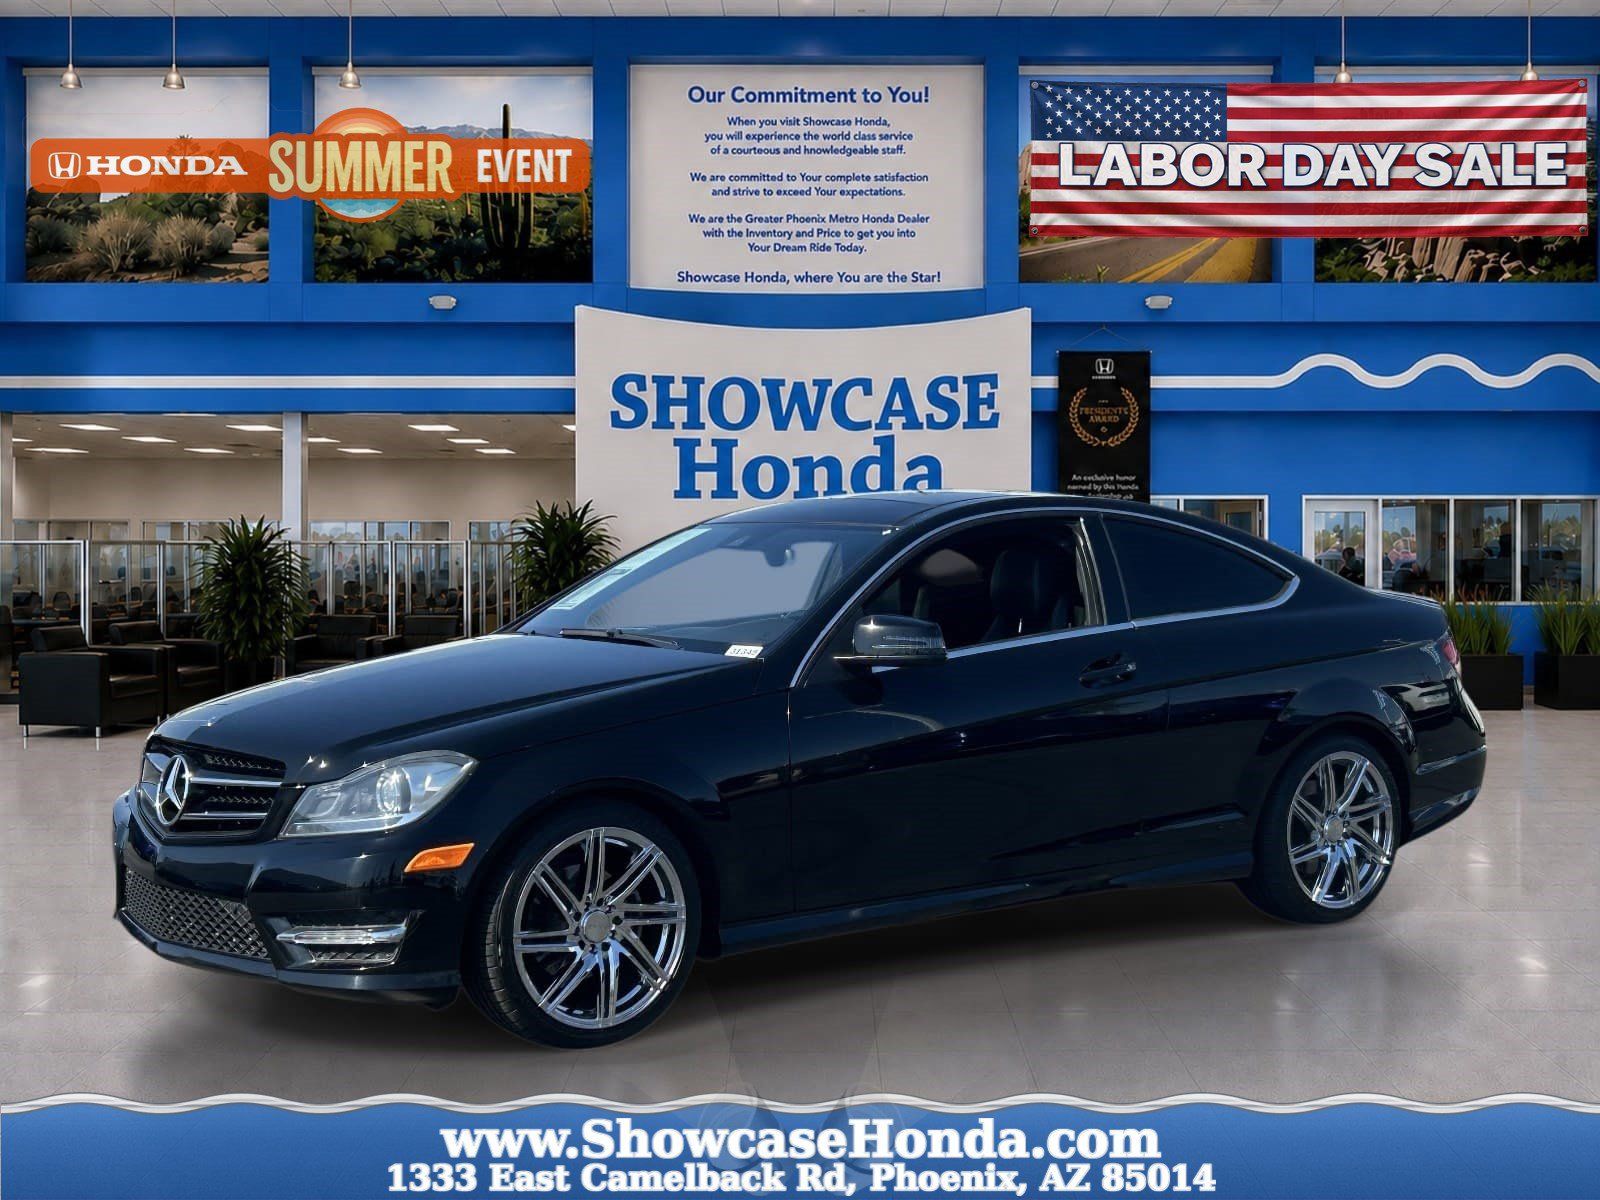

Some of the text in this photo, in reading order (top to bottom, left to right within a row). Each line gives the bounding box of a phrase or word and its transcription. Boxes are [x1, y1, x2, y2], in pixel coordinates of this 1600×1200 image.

[687, 85, 930, 104] Our Commitment to You!
[726, 115, 891, 129] When you visit Showcase Honda,
[704, 130, 914, 144] you will experience the world class service
[710, 144, 721, 155] of
[722, 147, 730, 155] a
[730, 146, 781, 155] courteous
[782, 144, 802, 155] and
[881, 144, 907, 155] staff.
[1058, 142, 1568, 187] LABOR DAY SALE
[689, 171, 929, 185] We are committed to Your complete satisfaction
[711, 186, 906, 200] and strive to exceed Your expectations.
[688, 213, 931, 224] We are the Greater Phoenix Metro Honda Dealer
[702, 227, 917, 241] with the Inventory and Price to get you into
[747, 242, 867, 255] Your Dream Ride Today.
[677, 270, 941, 286] Showcase Honda, where You are the Star!
[610, 373, 1000, 432] SHOWCASE
[673, 434, 942, 500] Honda
